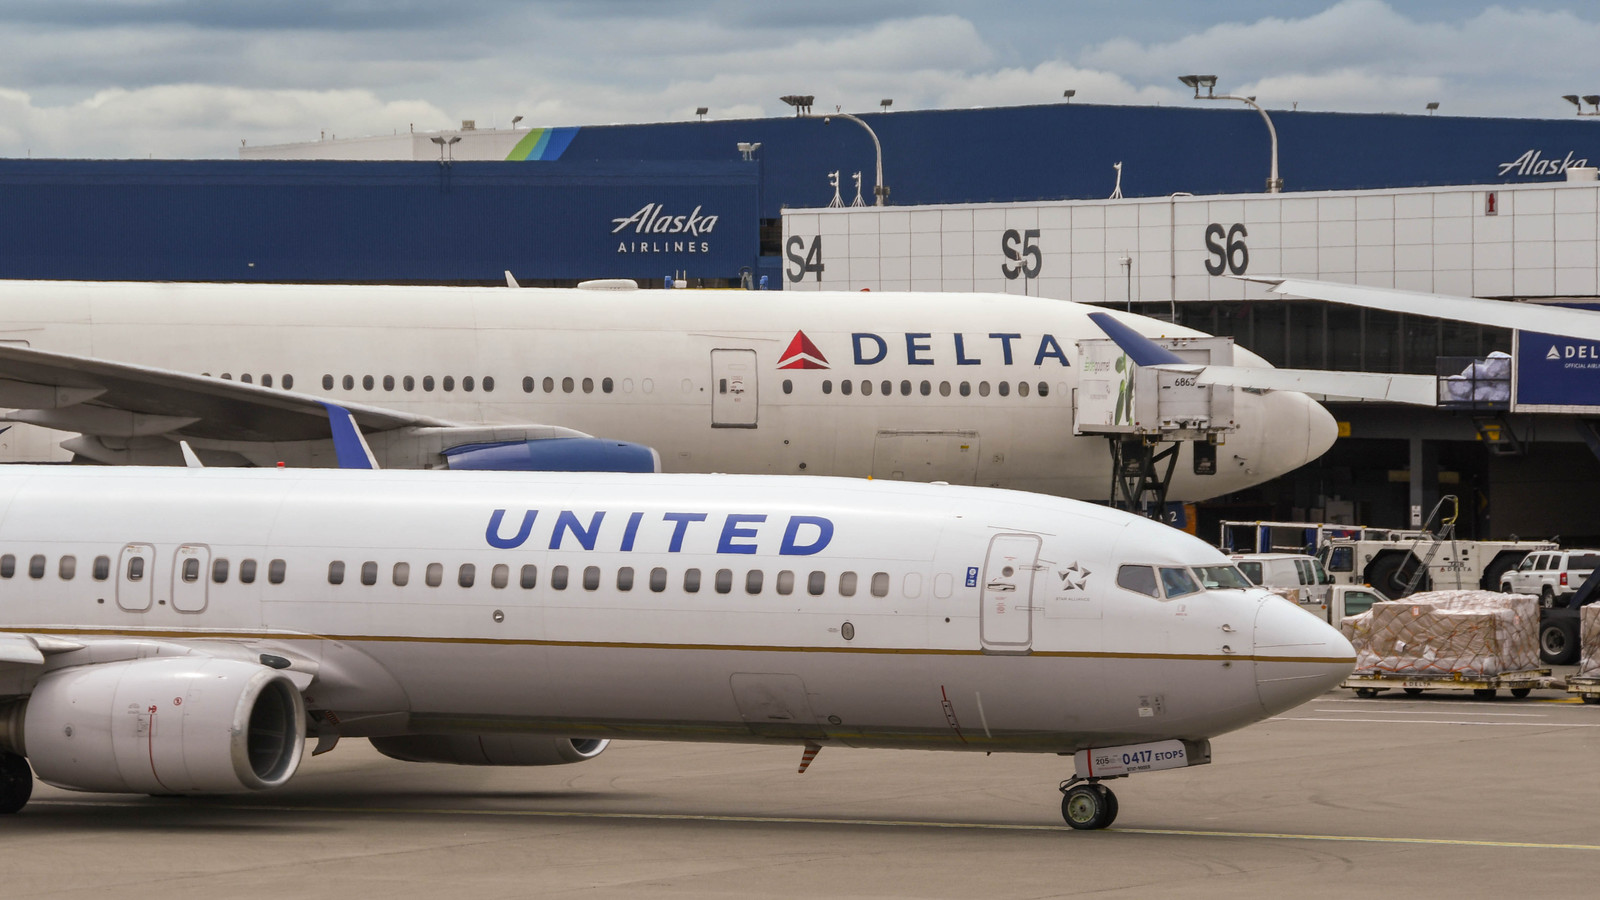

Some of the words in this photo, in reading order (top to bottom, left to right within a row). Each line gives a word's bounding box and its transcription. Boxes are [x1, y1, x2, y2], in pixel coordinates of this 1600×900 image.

[611, 202, 719, 237] Alaska
[617, 241, 709, 253] AIRLINES
[786, 235, 825, 283] S4
[1001, 229, 1042, 280] S5
[1204, 222, 1249, 276] S6
[851, 332, 1071, 367] DELTA
[485, 509, 834, 556] UNITED
[1122, 750, 1152, 765] 0417
[1155, 749, 1184, 761] ETOPS
